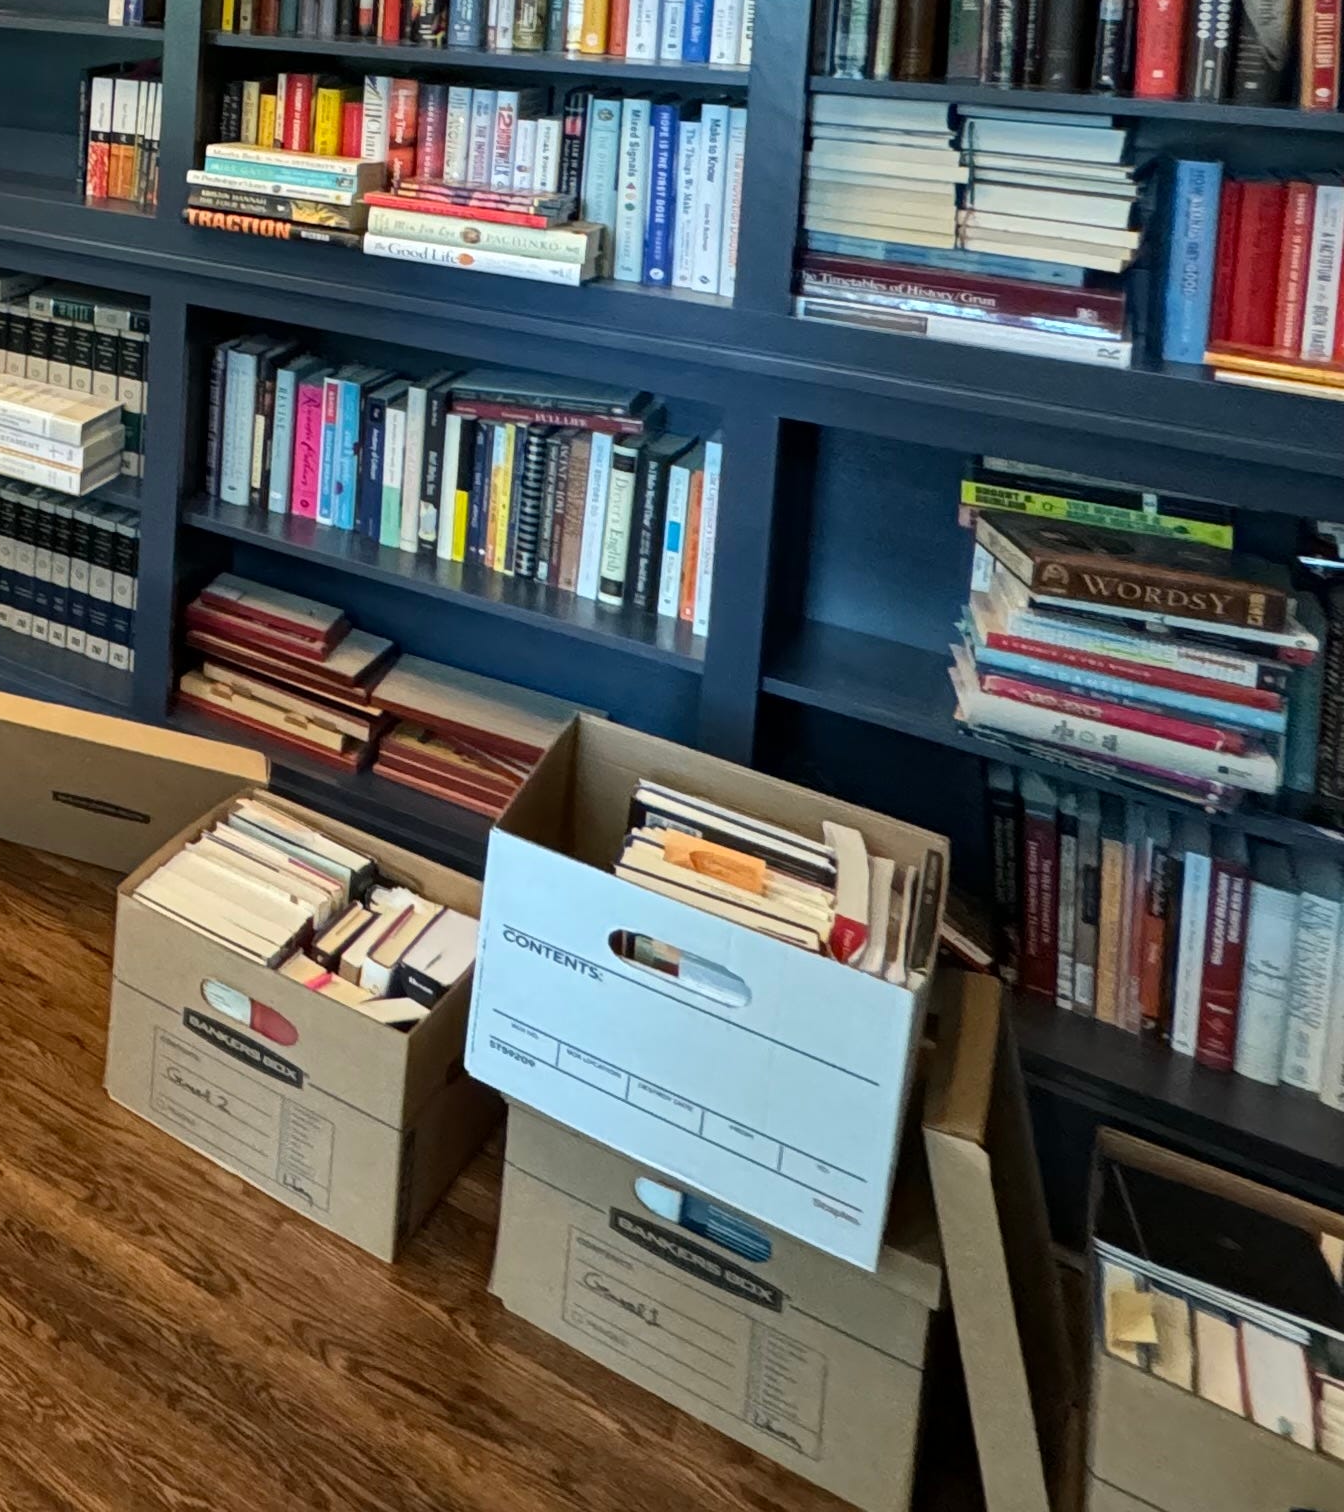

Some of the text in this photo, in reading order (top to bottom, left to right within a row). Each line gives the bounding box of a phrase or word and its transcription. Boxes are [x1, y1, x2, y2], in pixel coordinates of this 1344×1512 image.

[497, 103, 514, 126] 12
[658, 111, 670, 138] HOPE
[624, 108, 642, 178] Mixed Signals
[709, 118, 722, 144] Make
[495, 152, 511, 177] WALK
[657, 151, 669, 171] THE
[706, 156, 720, 183] Know
[655, 171, 668, 198] FIRST
[187, 207, 293, 242] TRACTION
[654, 198, 667, 224] DOSE
[387, 242, 430, 261] Good
[430, 248, 458, 266] Life
[820, 272, 883, 292] Timetables
[888, 281, 904, 296] of
[904, 283, 997, 308] History/Grun
[605, 475, 629, 575] Dreyer's English
[1082, 573, 1234, 617] WORDSY
[502, 928, 606, 982] CONTENTS:
[188, 1015, 299, 1081] BANKERS BOX
[616, 1213, 775, 1305] BANKERS BOX
